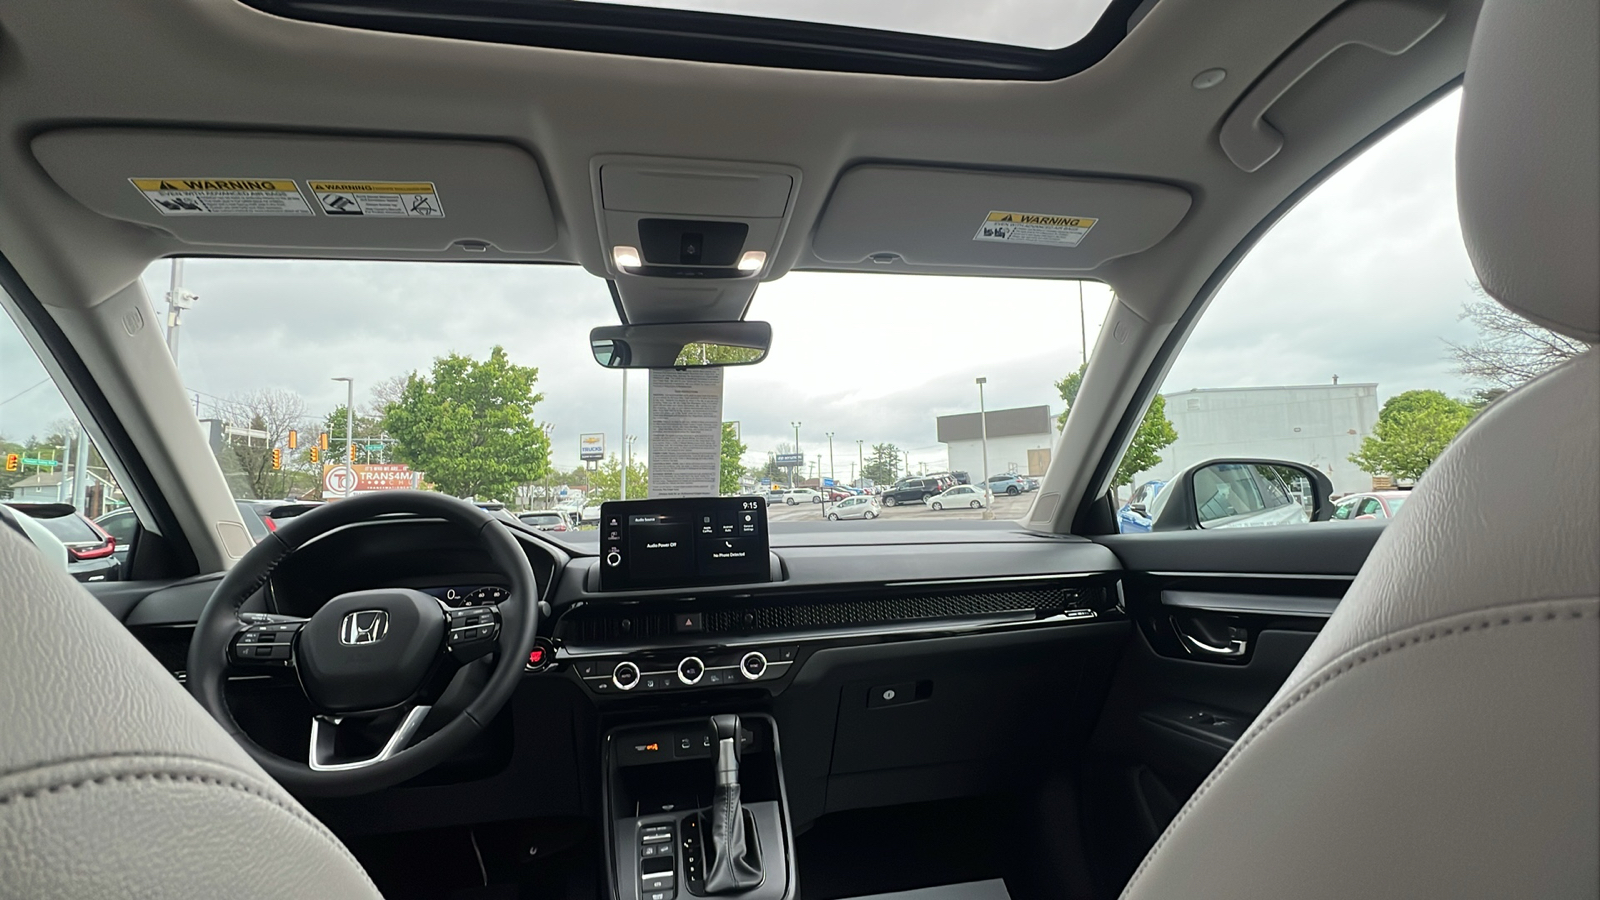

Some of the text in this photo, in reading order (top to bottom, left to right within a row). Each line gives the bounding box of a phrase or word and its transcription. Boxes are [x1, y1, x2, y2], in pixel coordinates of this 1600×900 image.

[183, 180, 276, 190] WARNING
[1020, 215, 1080, 226] WARNING
[742, 501, 758, 509] 9:15
[447, 589, 456, 600] 0
